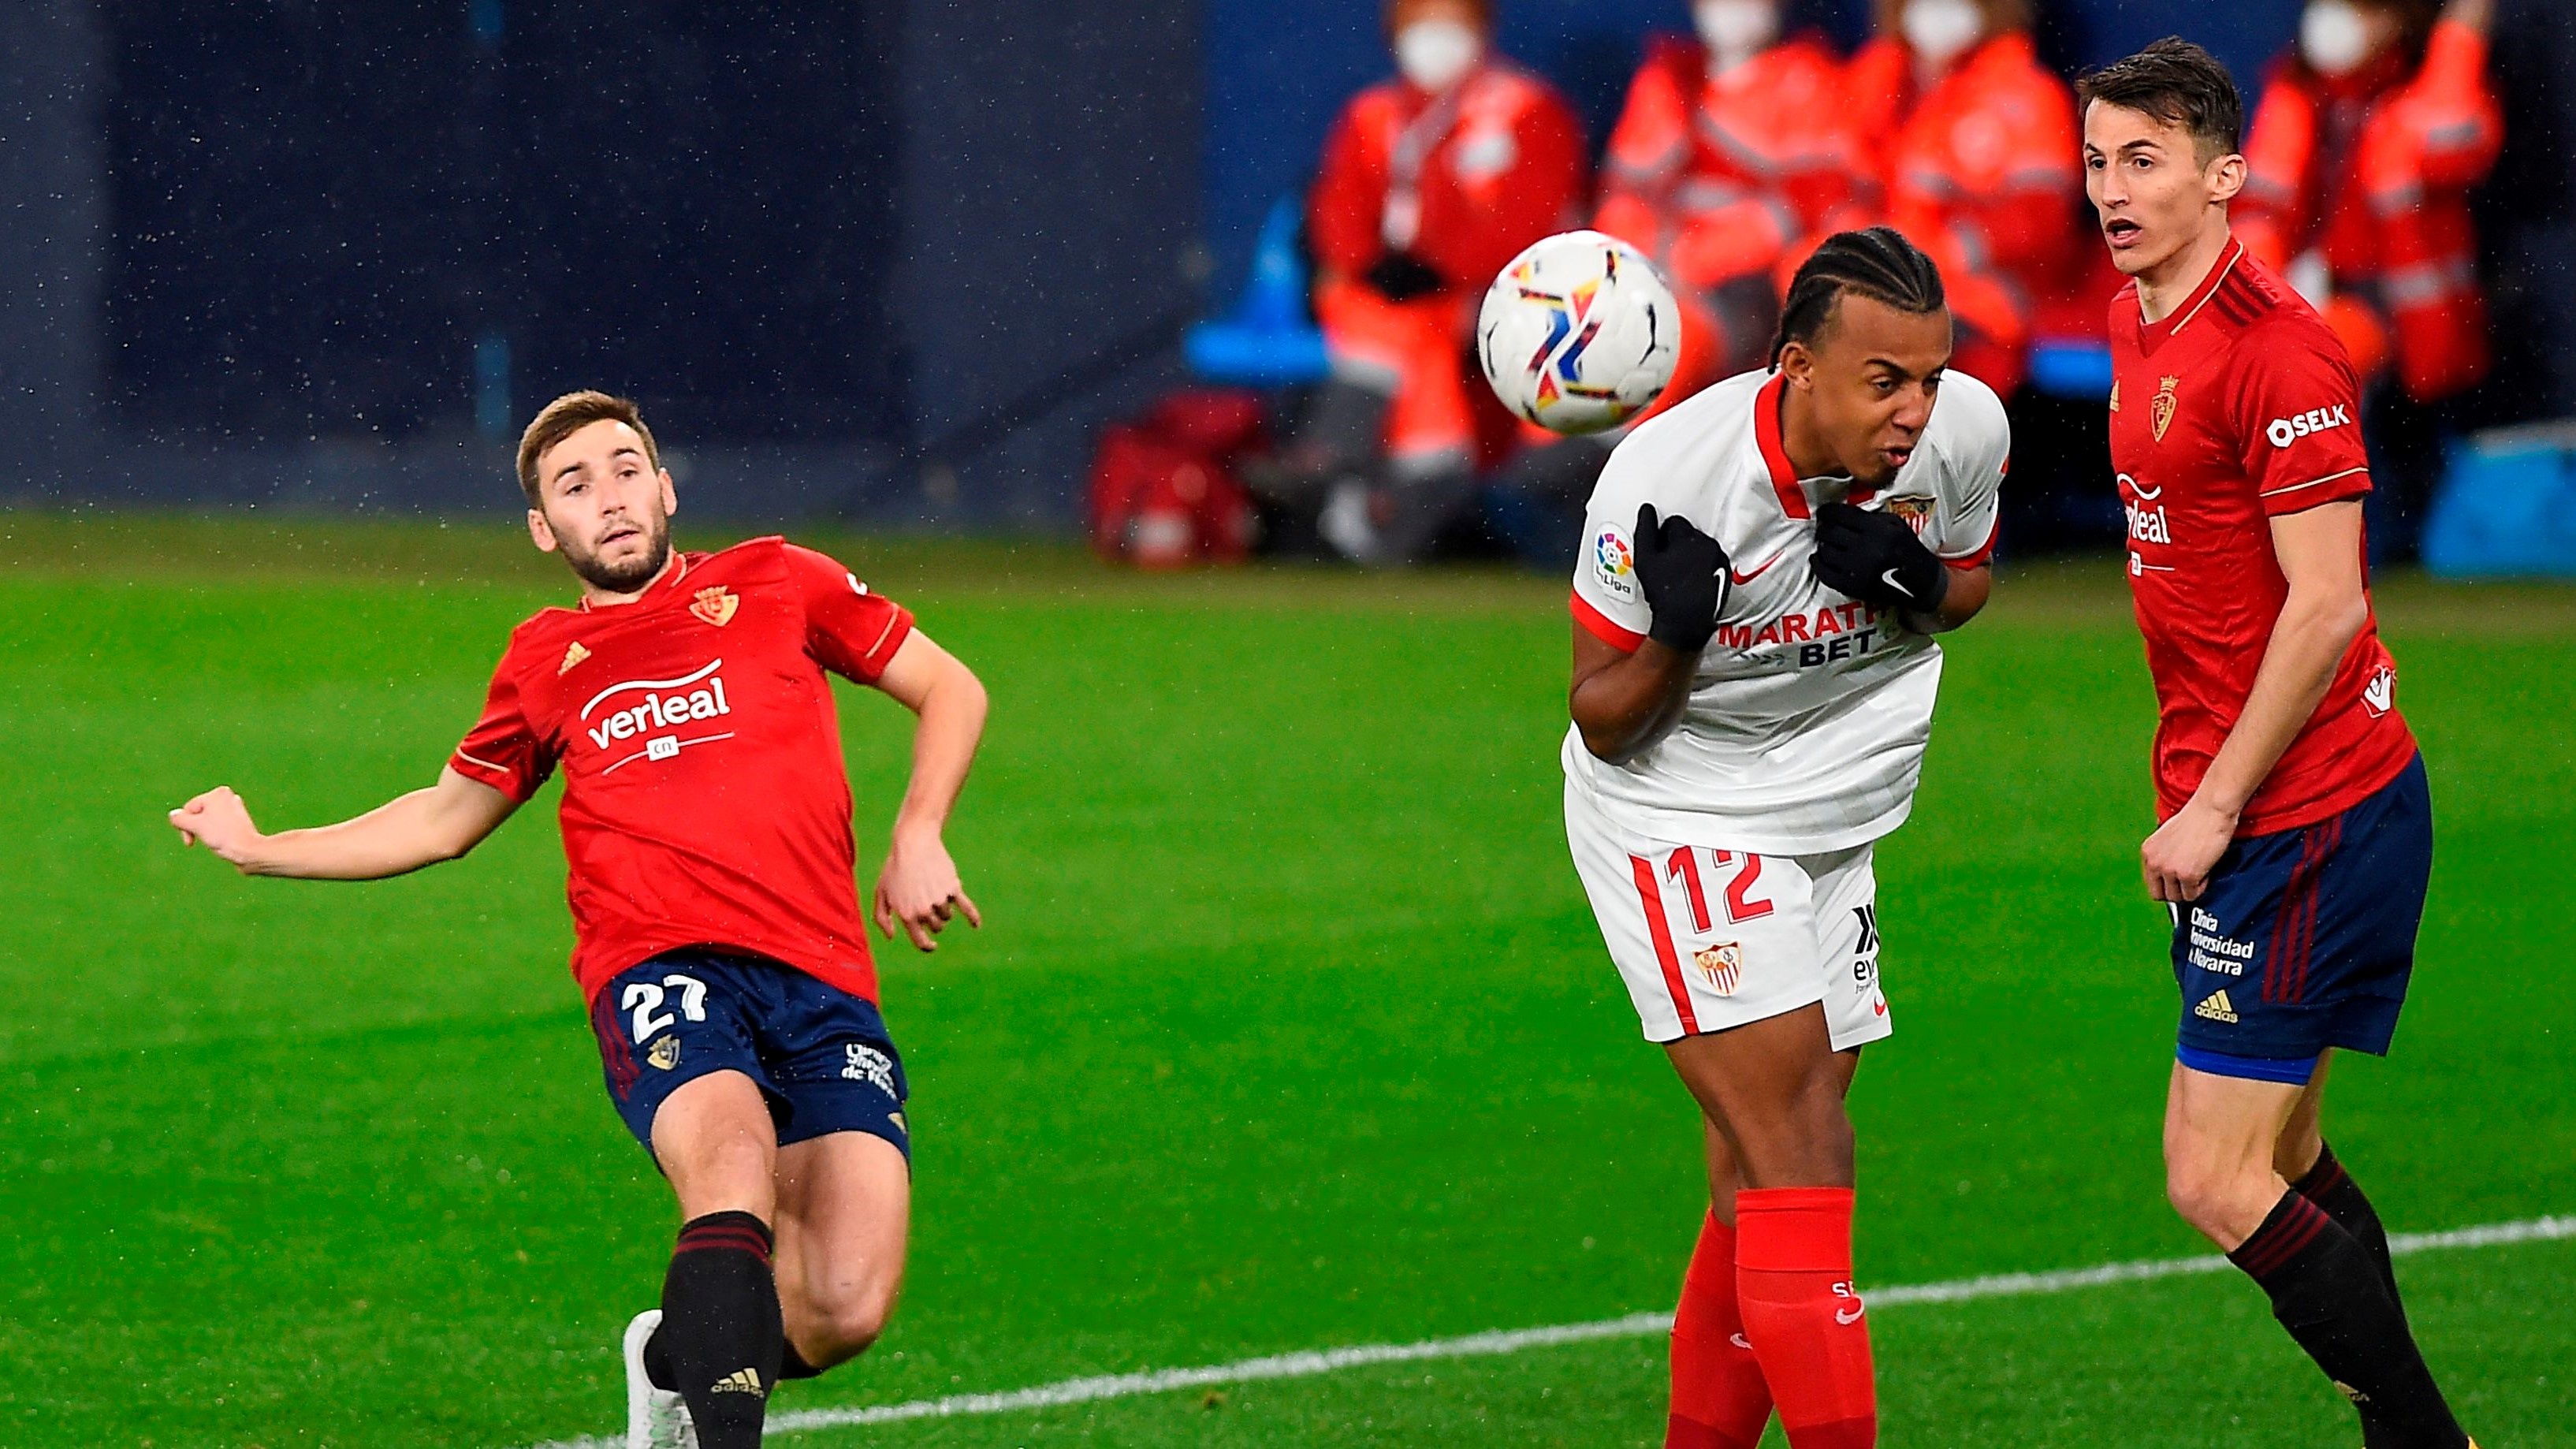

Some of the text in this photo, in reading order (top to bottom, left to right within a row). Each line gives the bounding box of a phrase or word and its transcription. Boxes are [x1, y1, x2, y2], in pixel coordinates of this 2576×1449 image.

[1799, 628, 1877, 668] BET
[587, 676, 731, 751] verleal
[653, 742, 672, 754] cn
[1664, 844, 1774, 934] 12
[620, 974, 708, 1045] 27
[2194, 1004, 2239, 1024] adidas
[710, 1383, 765, 1399] adidas
